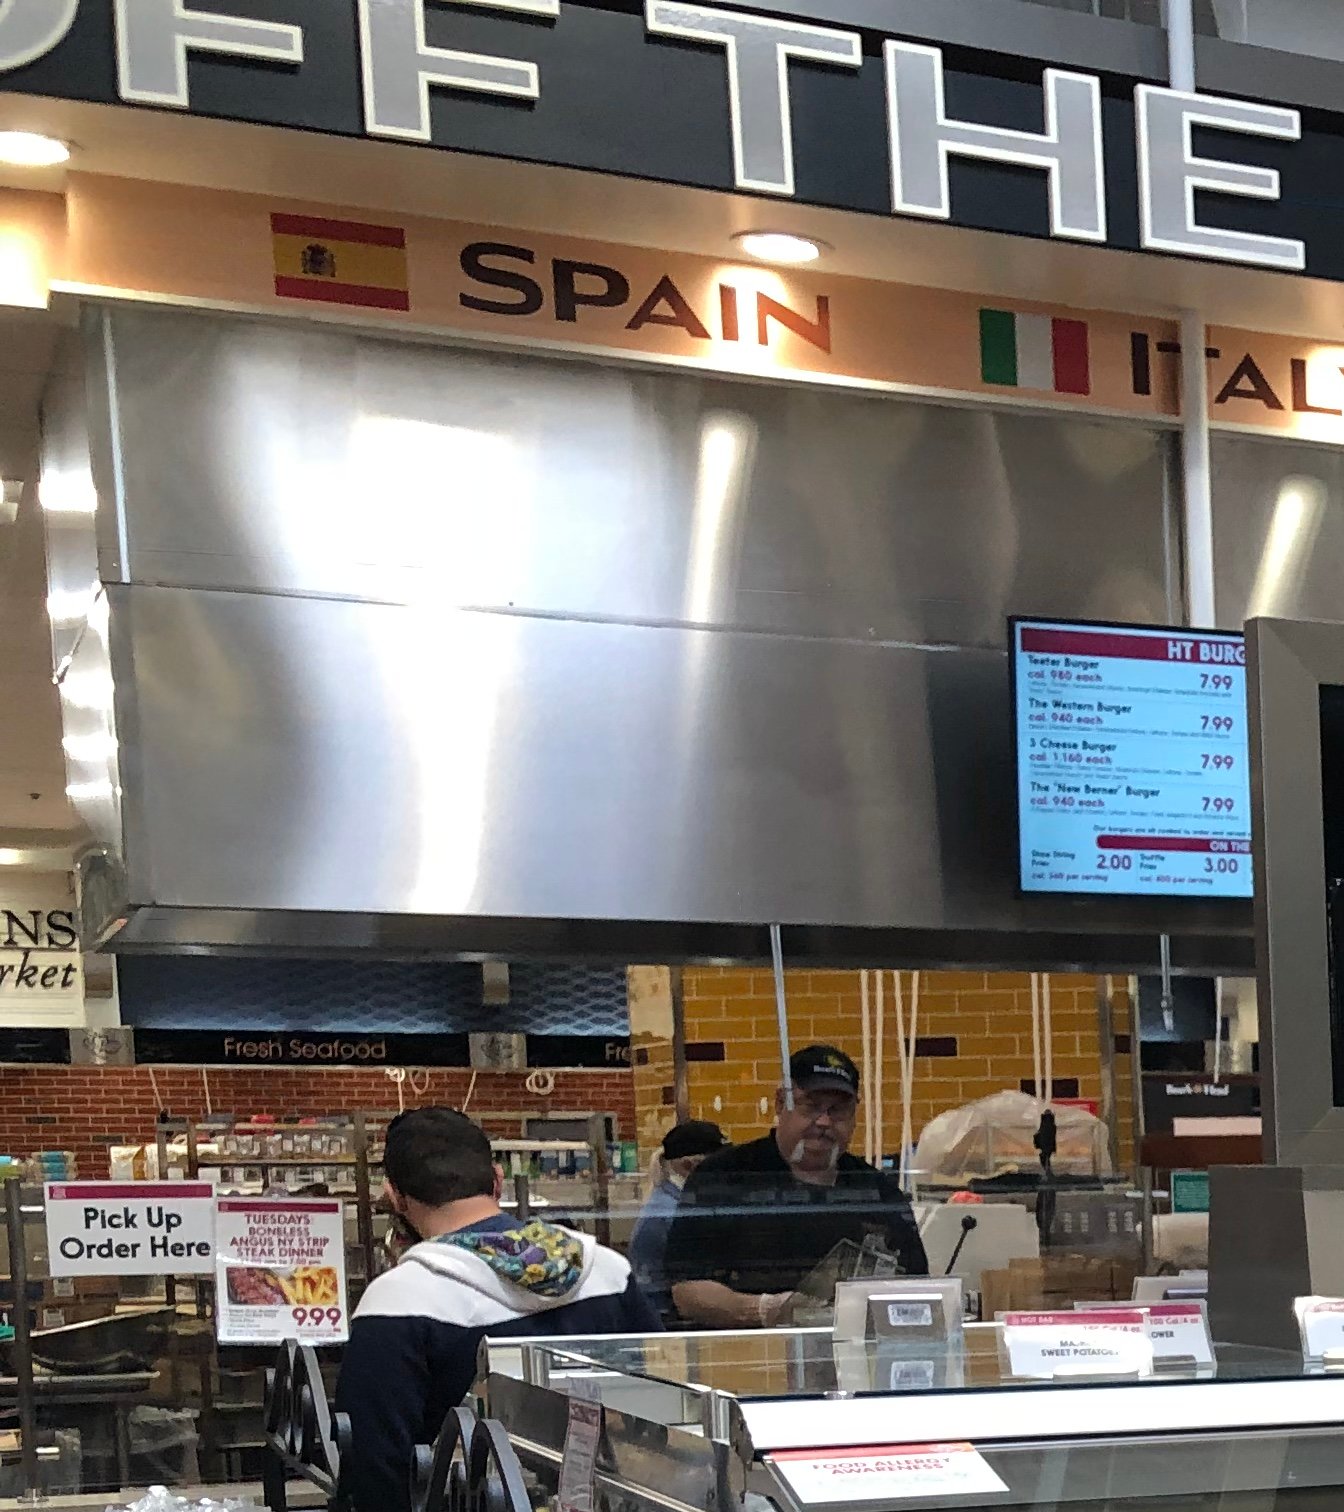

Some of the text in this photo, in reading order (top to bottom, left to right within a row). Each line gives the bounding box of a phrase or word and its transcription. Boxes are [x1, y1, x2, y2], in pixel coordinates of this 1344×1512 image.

[0, 0, 562, 142] FF
[644, 0, 1306, 270] THE
[458, 240, 832, 355] SPAIN
[1168, 640, 1194, 661] HT
[1064, 657, 1100, 670] Burger
[1076, 672, 1103, 684] each
[1199, 673, 1233, 690] 7.99
[1028, 697, 1132, 716] The Western Burger
[1076, 715, 1104, 727] each
[1201, 715, 1234, 732] 7.99
[1039, 738, 1078, 751] Cheese
[1082, 740, 1117, 753] Burger
[1086, 755, 1112, 766] each
[1201, 754, 1234, 770] 7.99
[1030, 781, 1050, 793] The
[1126, 785, 1161, 798] Burger
[1202, 797, 1234, 813] 7.99
[1209, 840, 1226, 852] ON
[1096, 854, 1132, 871] 2.00
[1203, 857, 1239, 874] 3.00
[223, 1037, 386, 1060] Fresh Seafood
[84, 1206, 183, 1234] Pick Up
[248, 1226, 310, 1237] BONELESS
[59, 1236, 211, 1260] Order Here
[229, 1236, 330, 1248] ANGUS NY STRIP
[236, 1247, 324, 1258] STEAK DINNER
[291, 1306, 342, 1327] 9.99
[1041, 1348, 1071, 1357] SWEET
[812, 1461, 868, 1470] FOOD
[831, 1463, 945, 1475] AWARENESS
